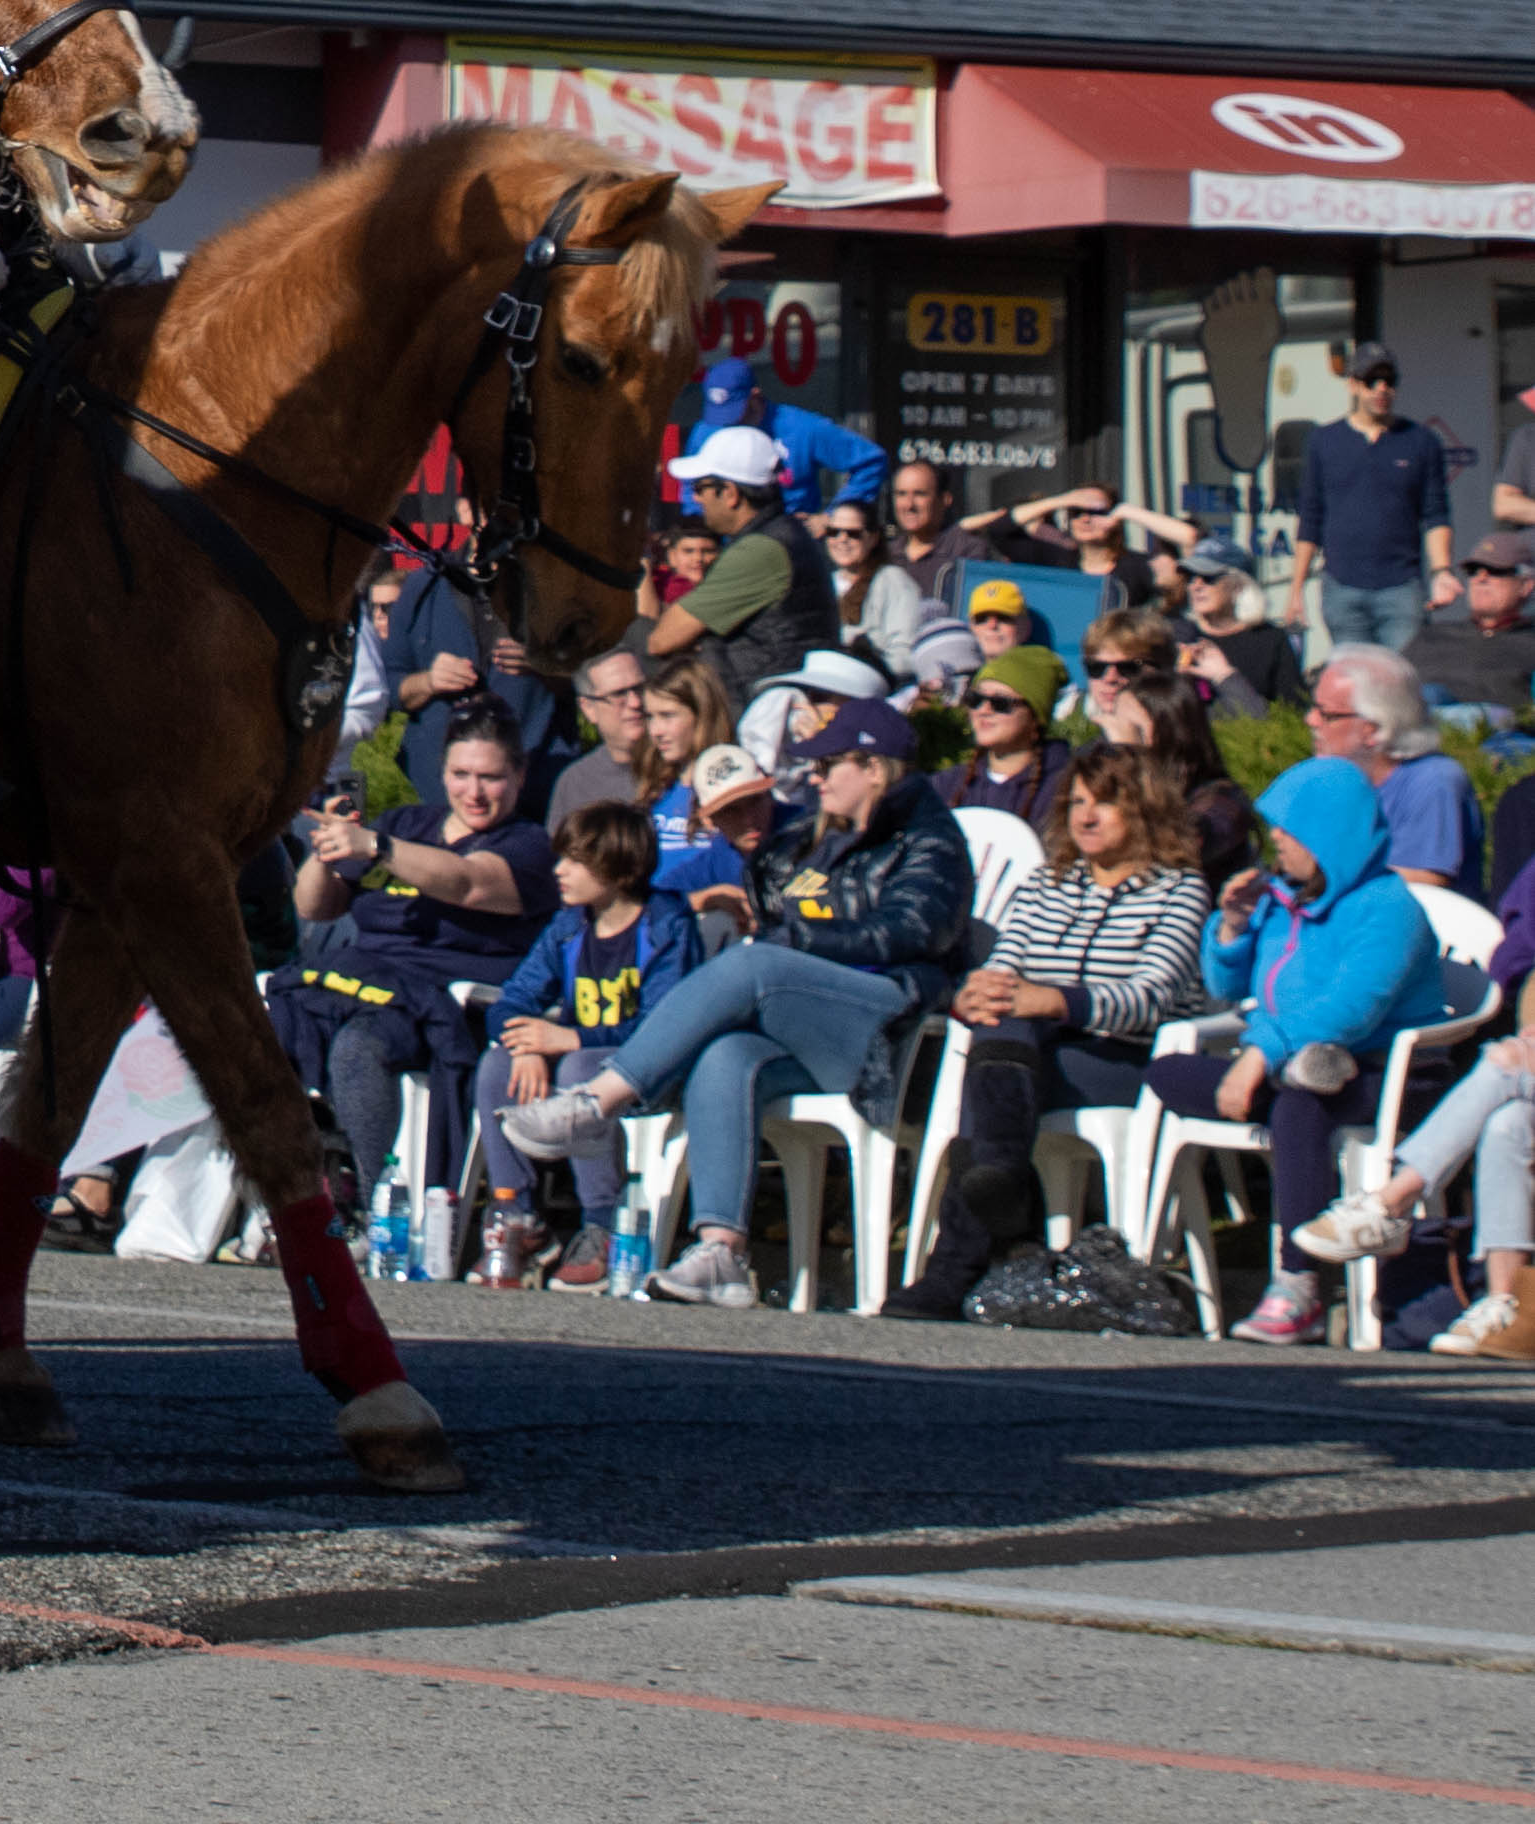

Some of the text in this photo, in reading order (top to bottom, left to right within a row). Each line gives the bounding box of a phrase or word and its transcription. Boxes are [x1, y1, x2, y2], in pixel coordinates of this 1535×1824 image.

[462, 63, 916, 183] MASSAGE
[922, 301, 1039, 346] 281-B
[900, 371, 1055, 397] OPEN 7 DAYS
